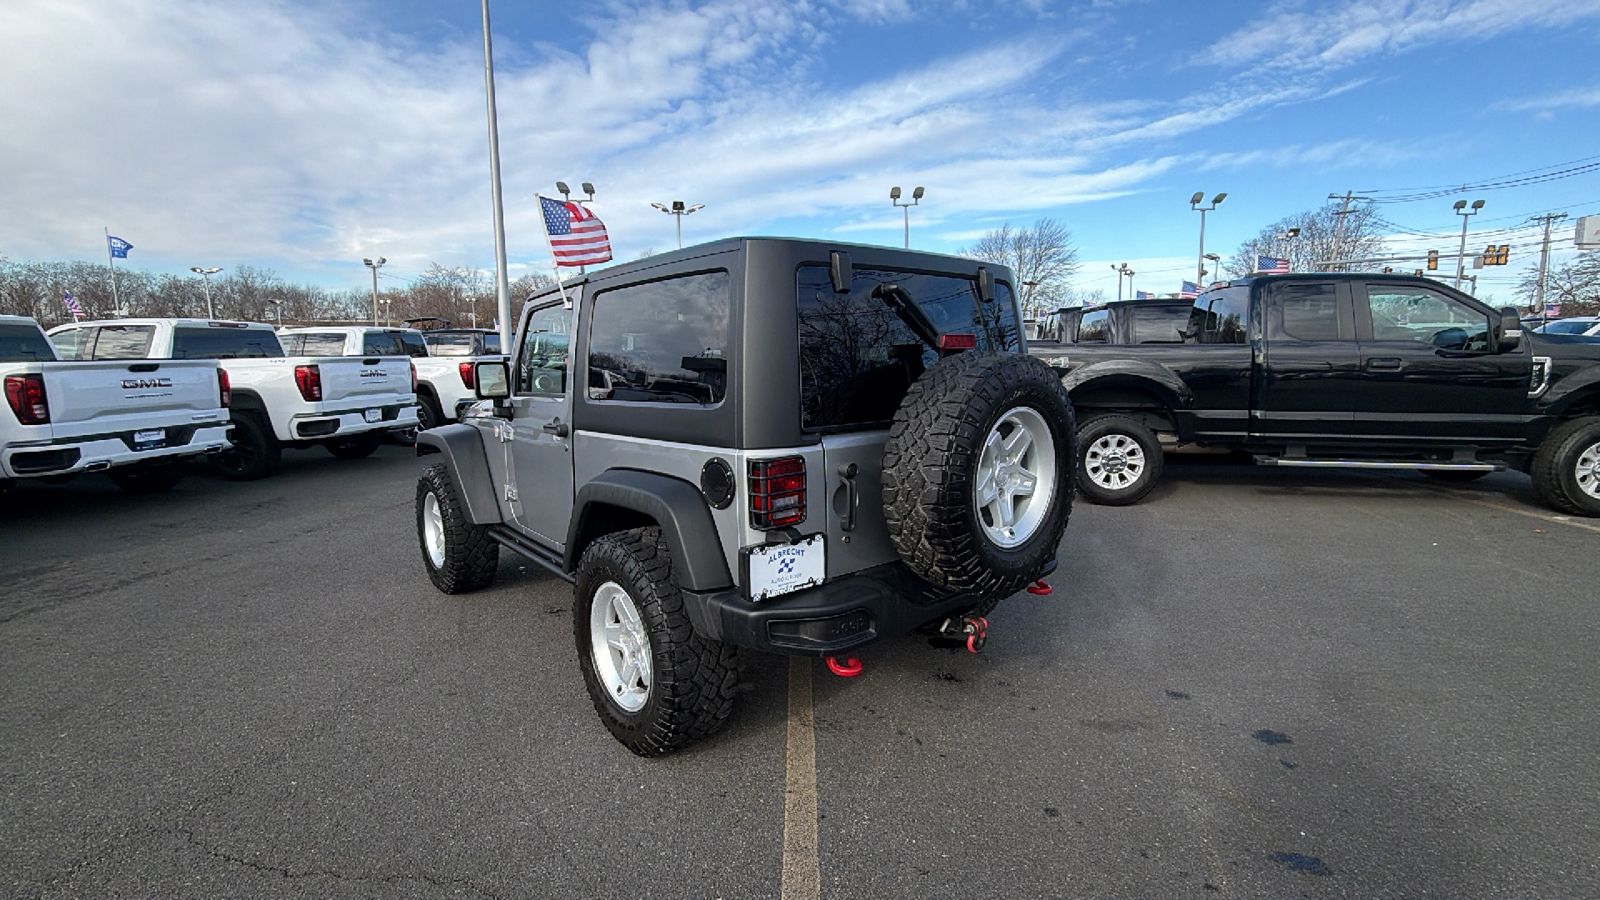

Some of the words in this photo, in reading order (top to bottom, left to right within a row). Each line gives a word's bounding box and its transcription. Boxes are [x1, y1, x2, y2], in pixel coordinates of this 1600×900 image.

[360, 369, 388, 377] GMC
[120, 378, 173, 389] GMC
[768, 548, 805, 564] ALBRECHT
